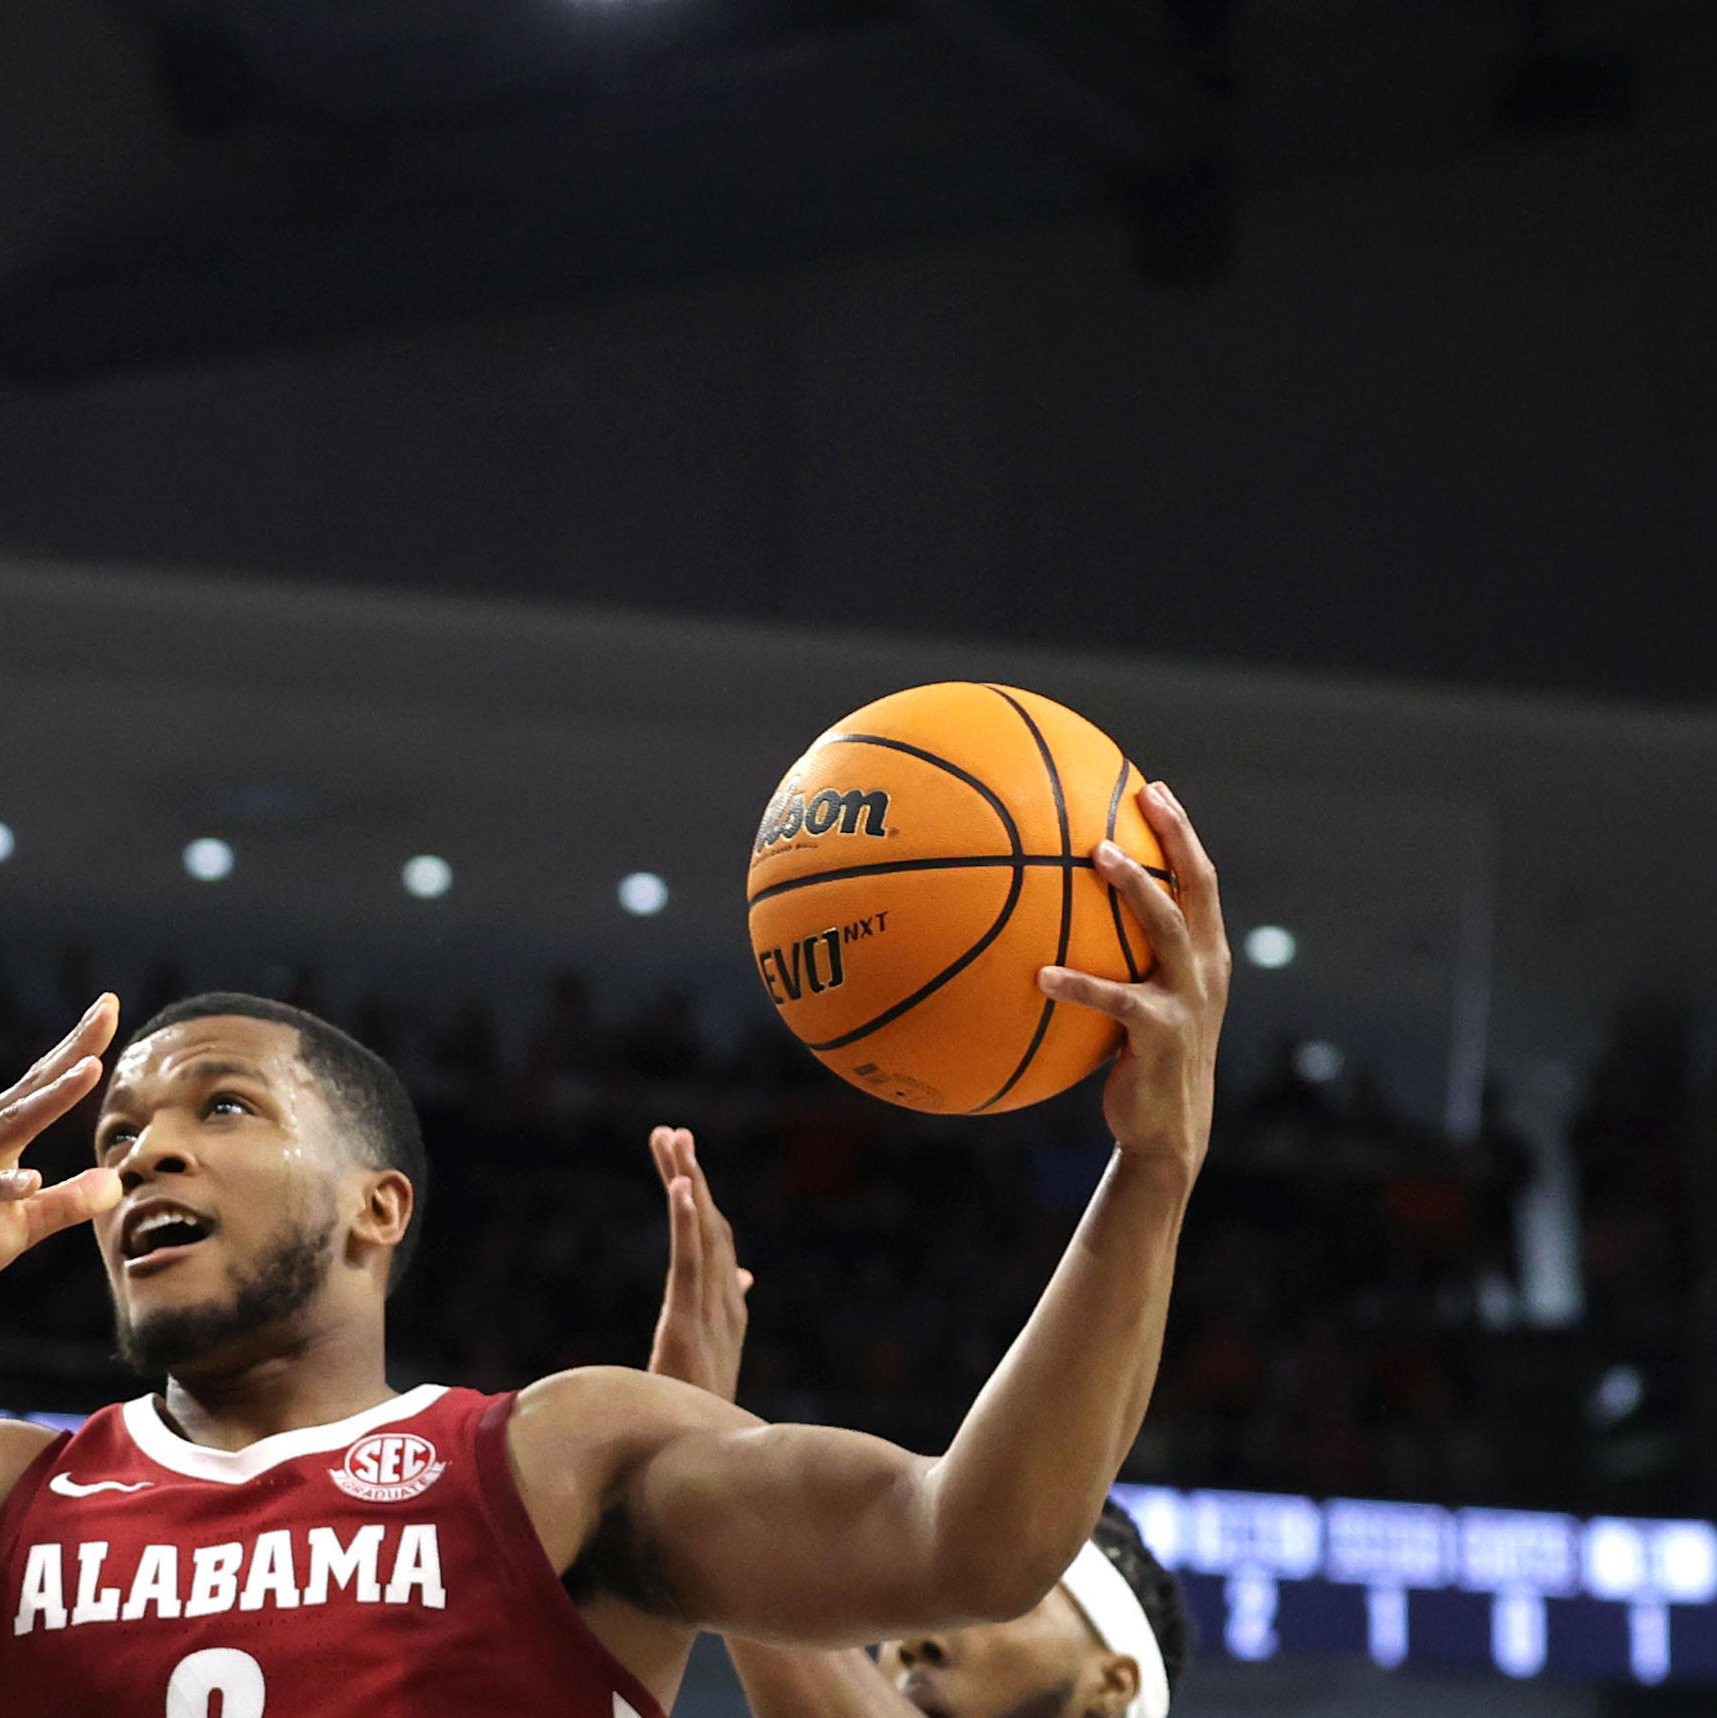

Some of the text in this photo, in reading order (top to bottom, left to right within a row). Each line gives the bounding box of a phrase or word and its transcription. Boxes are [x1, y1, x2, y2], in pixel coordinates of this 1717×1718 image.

[844, 911, 889, 944] NXT
[354, 1439, 427, 1484] SEC
[14, 1524, 446, 1635] ALABAMA
